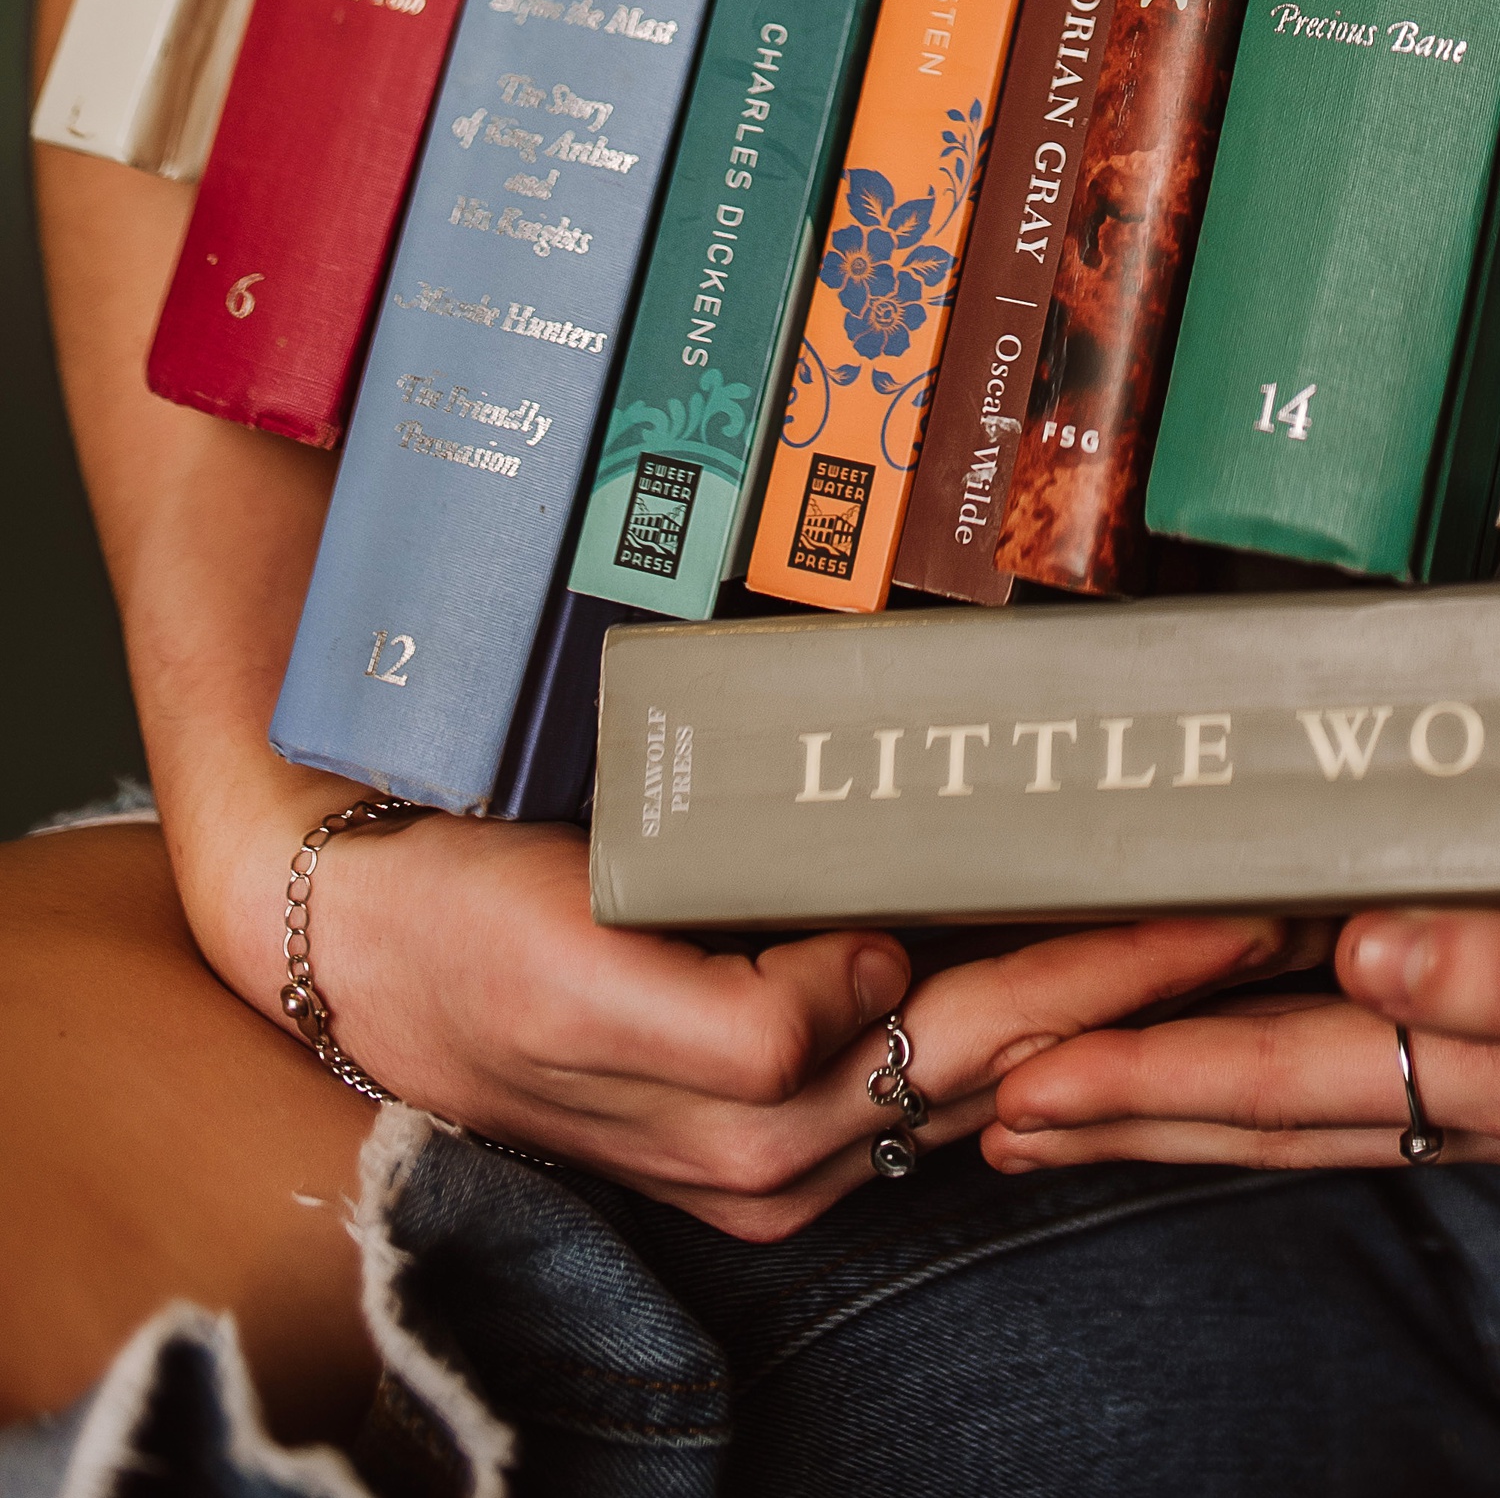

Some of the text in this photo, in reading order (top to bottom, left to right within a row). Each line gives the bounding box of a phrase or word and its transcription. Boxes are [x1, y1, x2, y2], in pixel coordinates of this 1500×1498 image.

[604, 4, 678, 45] Mast
[1270, 3, 1468, 64] Precious Bane
[681, 22, 789, 367] CHARLES DICKENS
[1015, 140, 1067, 265] GRAY
[225, 272, 266, 319] 6
[500, 302, 608, 355] Hunters
[396, 372, 553, 447] The Friendly
[1042, 421, 1100, 454] FSG
[1253, 382, 1318, 441] 14
[394, 420, 523, 478] Persuasion
[643, 461, 697, 482] SWEET
[816, 462, 869, 485] SWEET
[638, 476, 692, 501] WATER
[811, 478, 866, 502] WATER
[954, 445, 1001, 546] Wilde
[620, 550, 674, 574] PRESS
[794, 551, 848, 575] PRESS
[364, 629, 417, 687] 12
[642, 706, 666, 837] SEAWOLF
[671, 725, 694, 815] PRESS
[795, 712, 1235, 803] LITTLE
